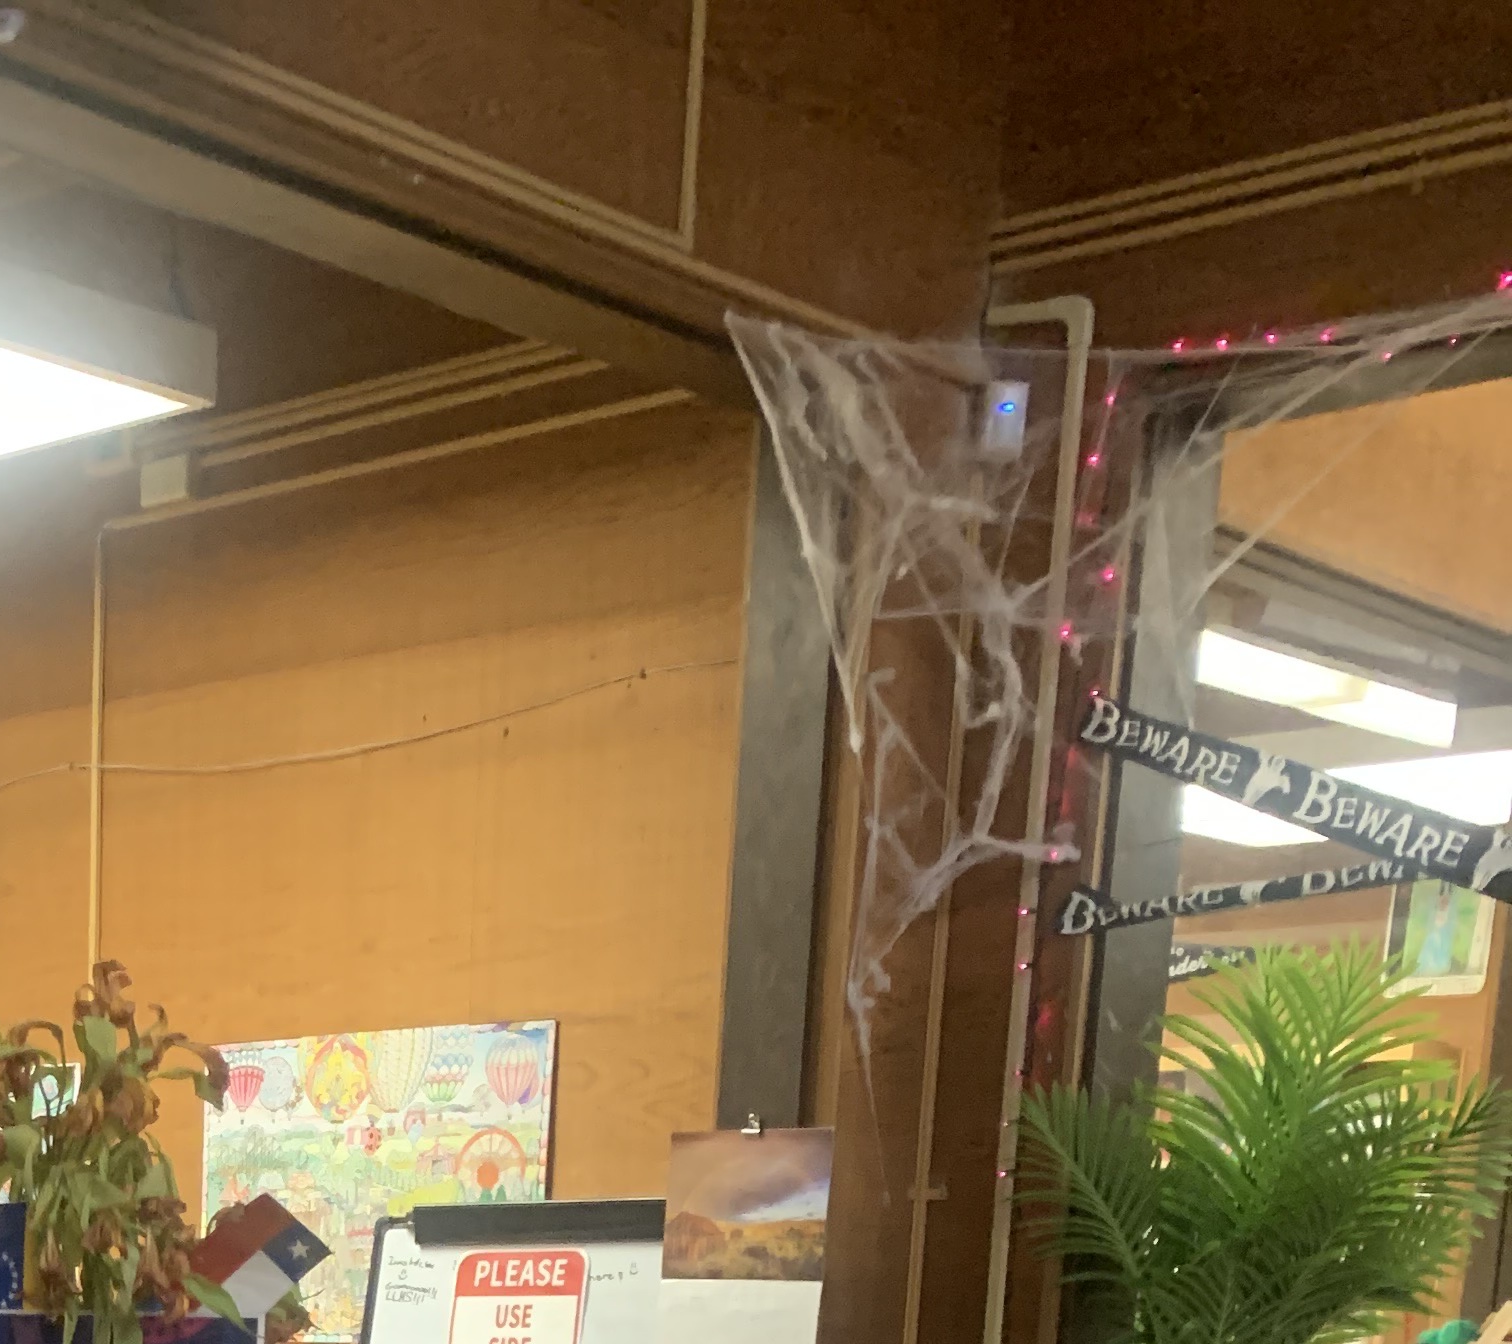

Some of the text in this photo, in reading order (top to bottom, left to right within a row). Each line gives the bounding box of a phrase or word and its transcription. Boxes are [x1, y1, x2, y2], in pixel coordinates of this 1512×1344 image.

[1080, 697, 1470, 868] BEWARE BEWARE
[474, 1259, 568, 1287] PLEASE
[495, 1304, 533, 1328] USE
